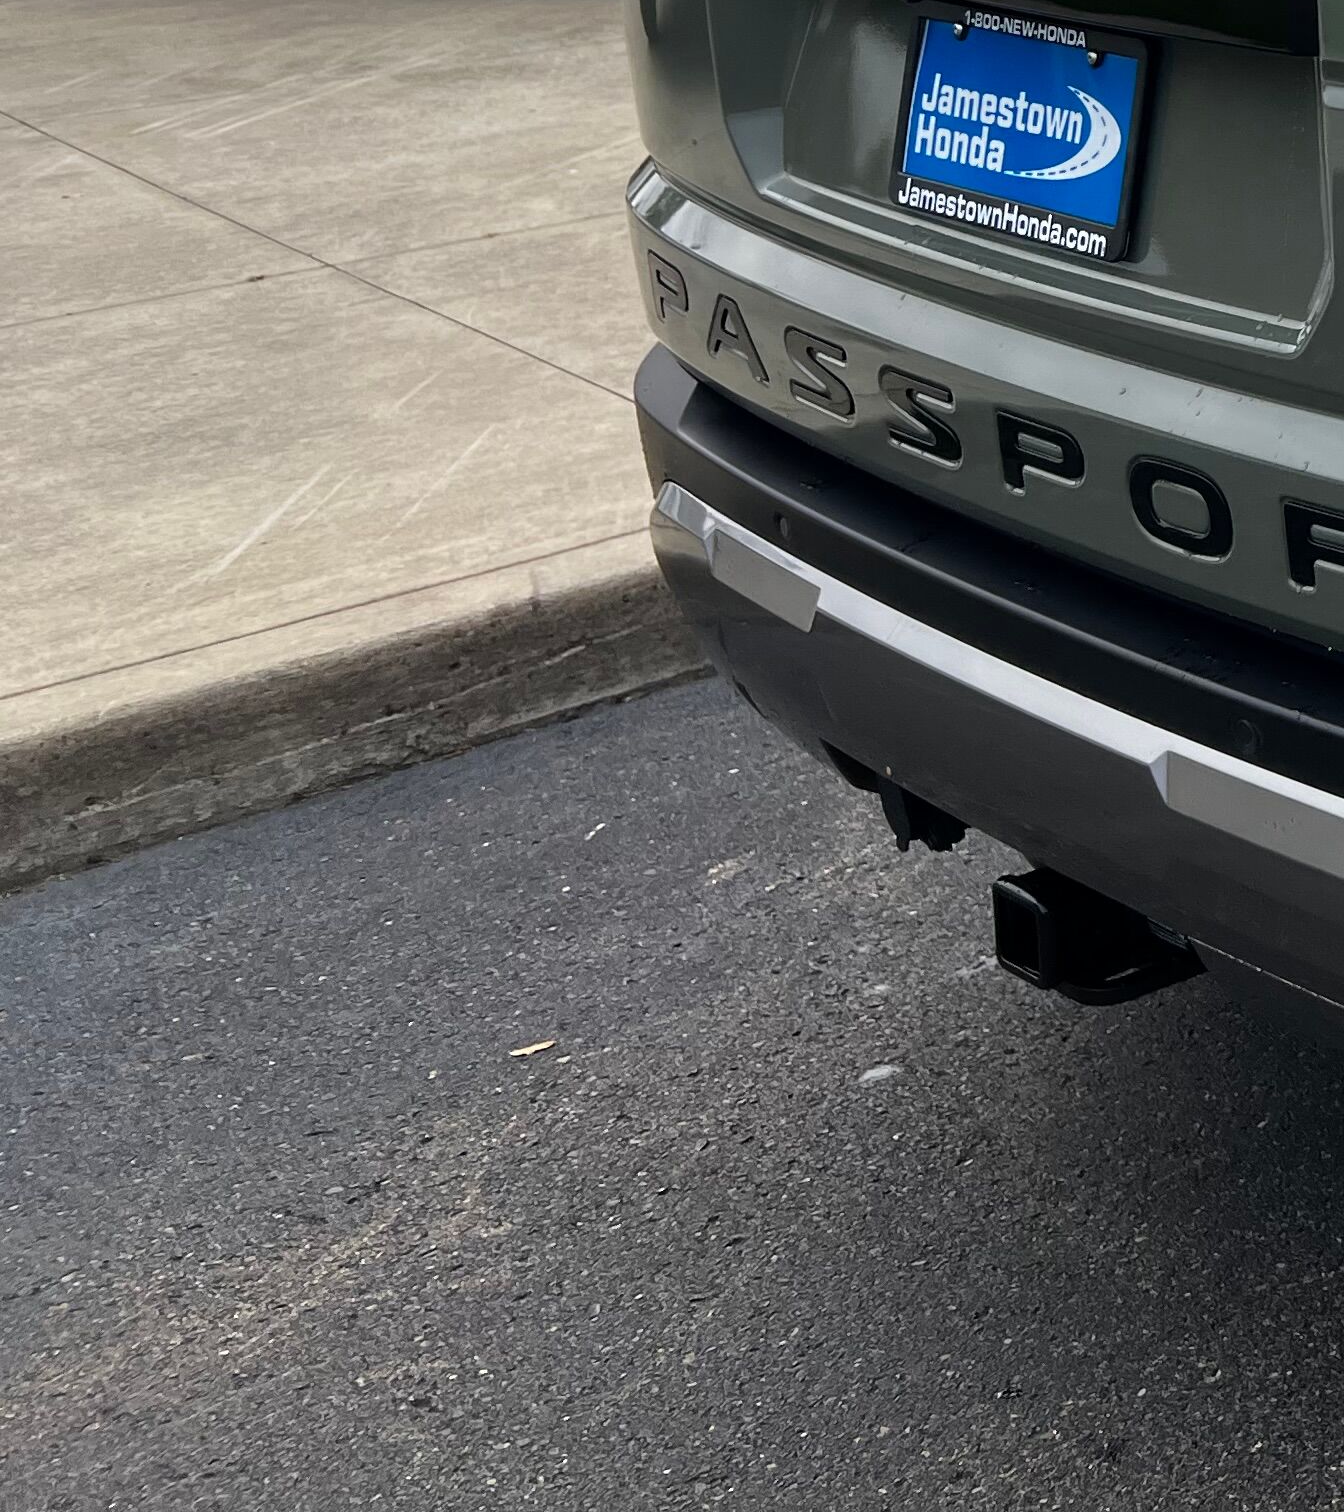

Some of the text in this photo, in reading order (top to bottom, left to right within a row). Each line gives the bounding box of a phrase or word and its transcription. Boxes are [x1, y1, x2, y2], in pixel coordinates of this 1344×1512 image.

[964, 9, 1087, 48] 1-800-NEW-HONDA
[921, 72, 1083, 145] Jamestown
[914, 113, 1006, 173] Honda
[898, 177, 1107, 257] JamestownHonda.com
